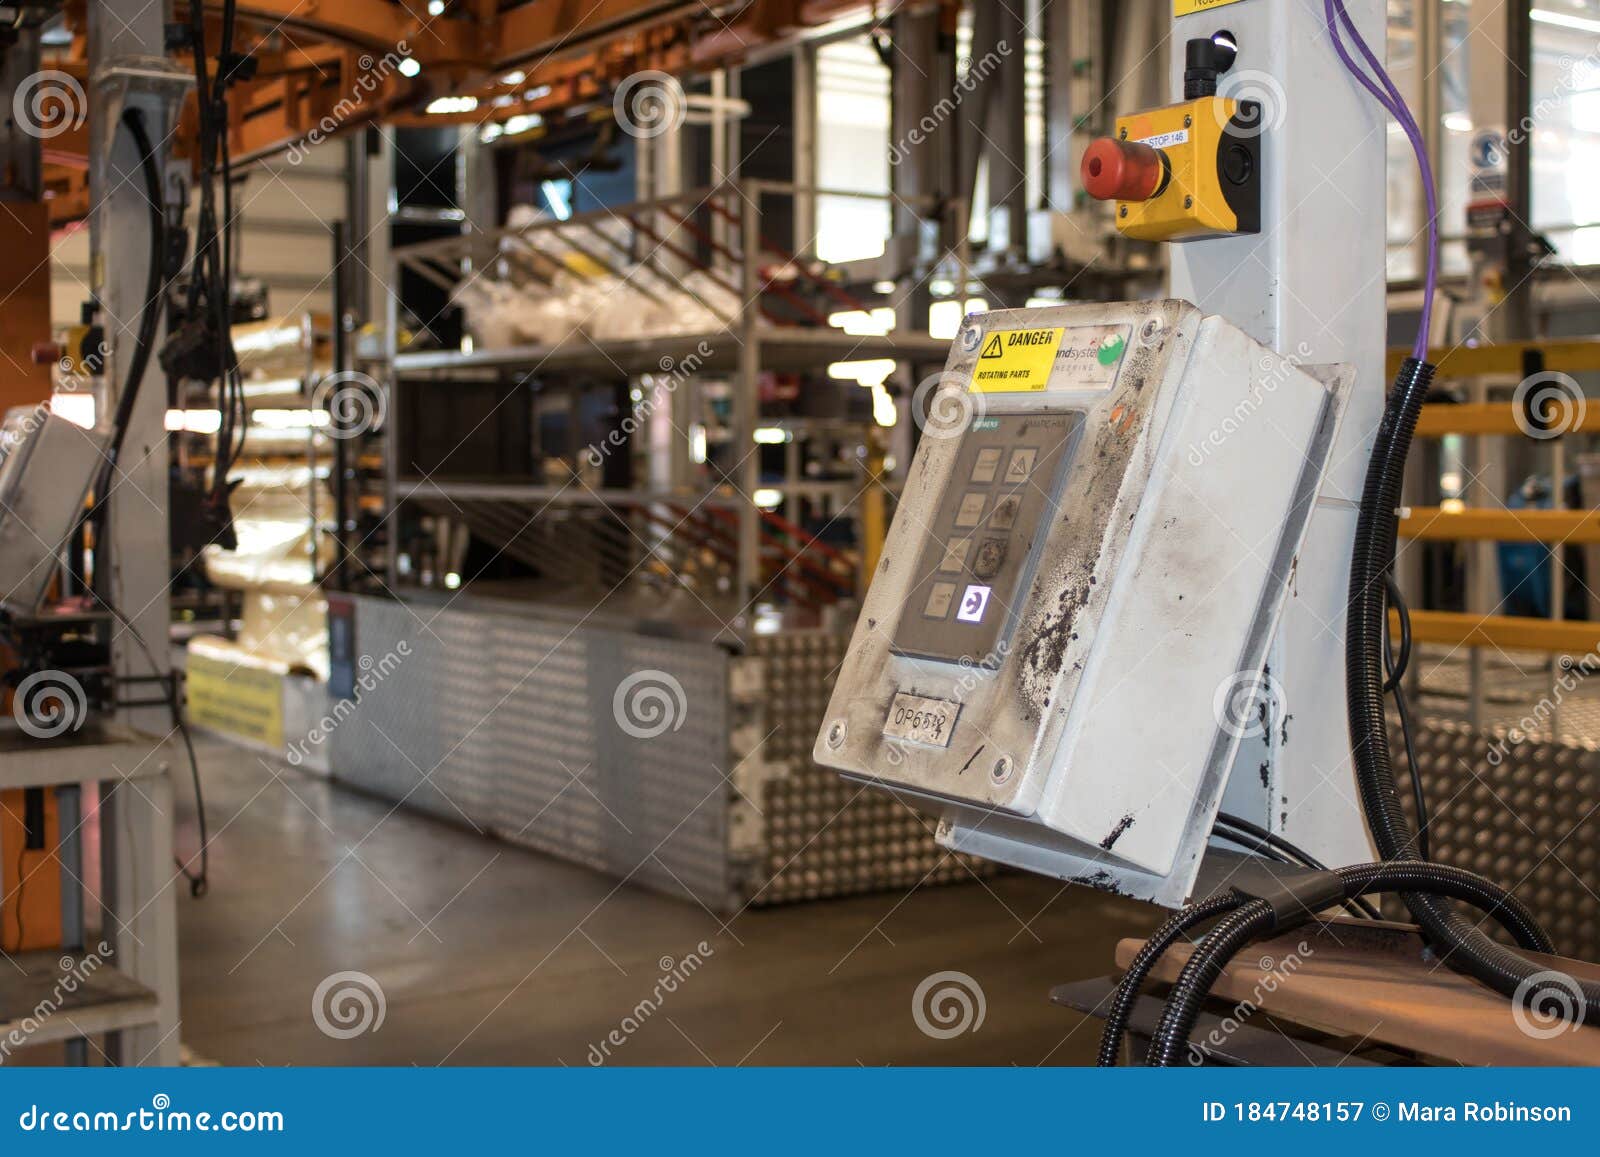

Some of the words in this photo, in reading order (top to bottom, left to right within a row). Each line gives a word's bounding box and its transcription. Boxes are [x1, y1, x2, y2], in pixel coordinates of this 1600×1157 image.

[1008, 331, 1053, 346] DANGER
[977, 371, 1008, 379] ROTATING
[1009, 370, 1030, 378] PARTS
